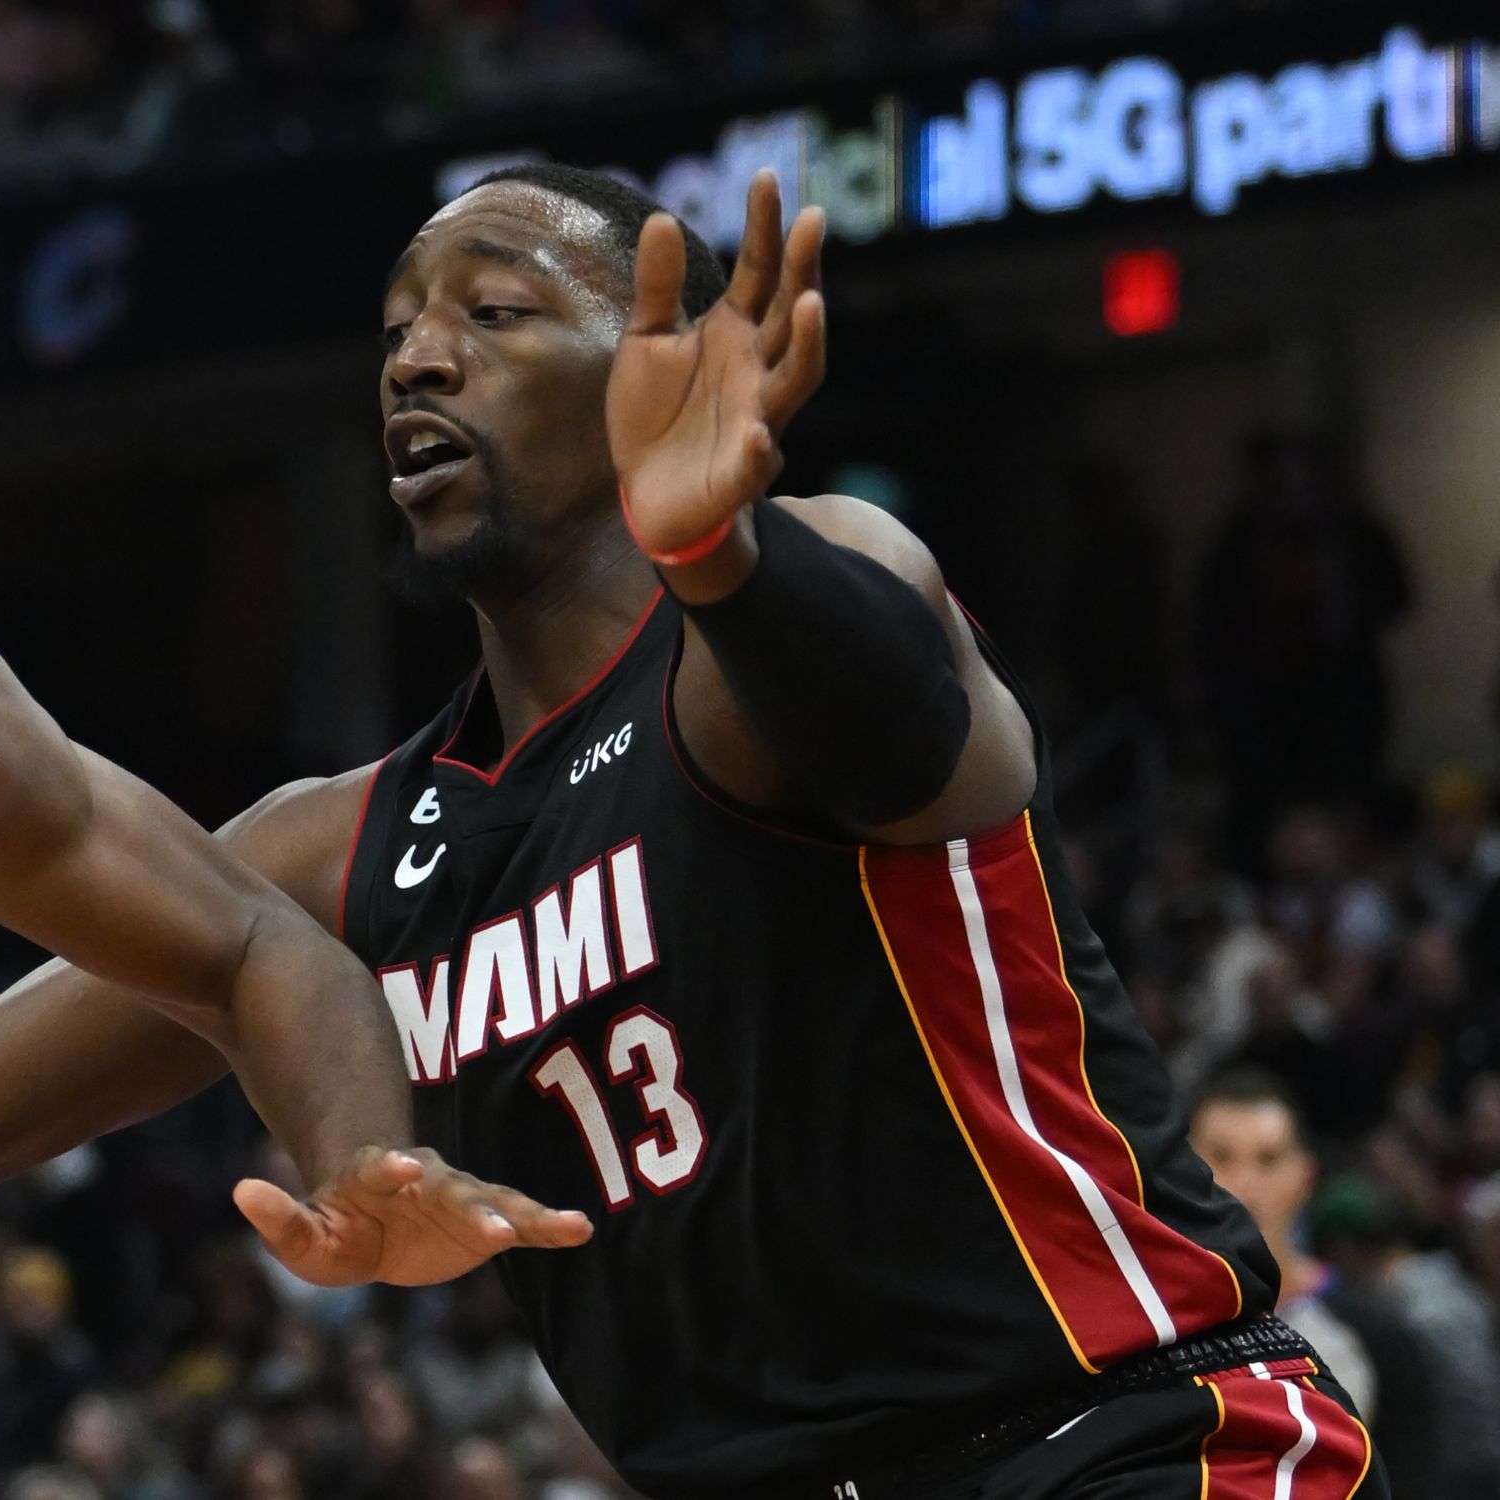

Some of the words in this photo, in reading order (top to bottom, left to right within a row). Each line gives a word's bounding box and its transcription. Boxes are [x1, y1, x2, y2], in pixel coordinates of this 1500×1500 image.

[1013, 56, 1189, 214] 5G
[409, 786, 441, 824] 6
[570, 722, 633, 785] UKG
[376, 834, 660, 1086] MAMI
[527, 1004, 707, 1213] 13
